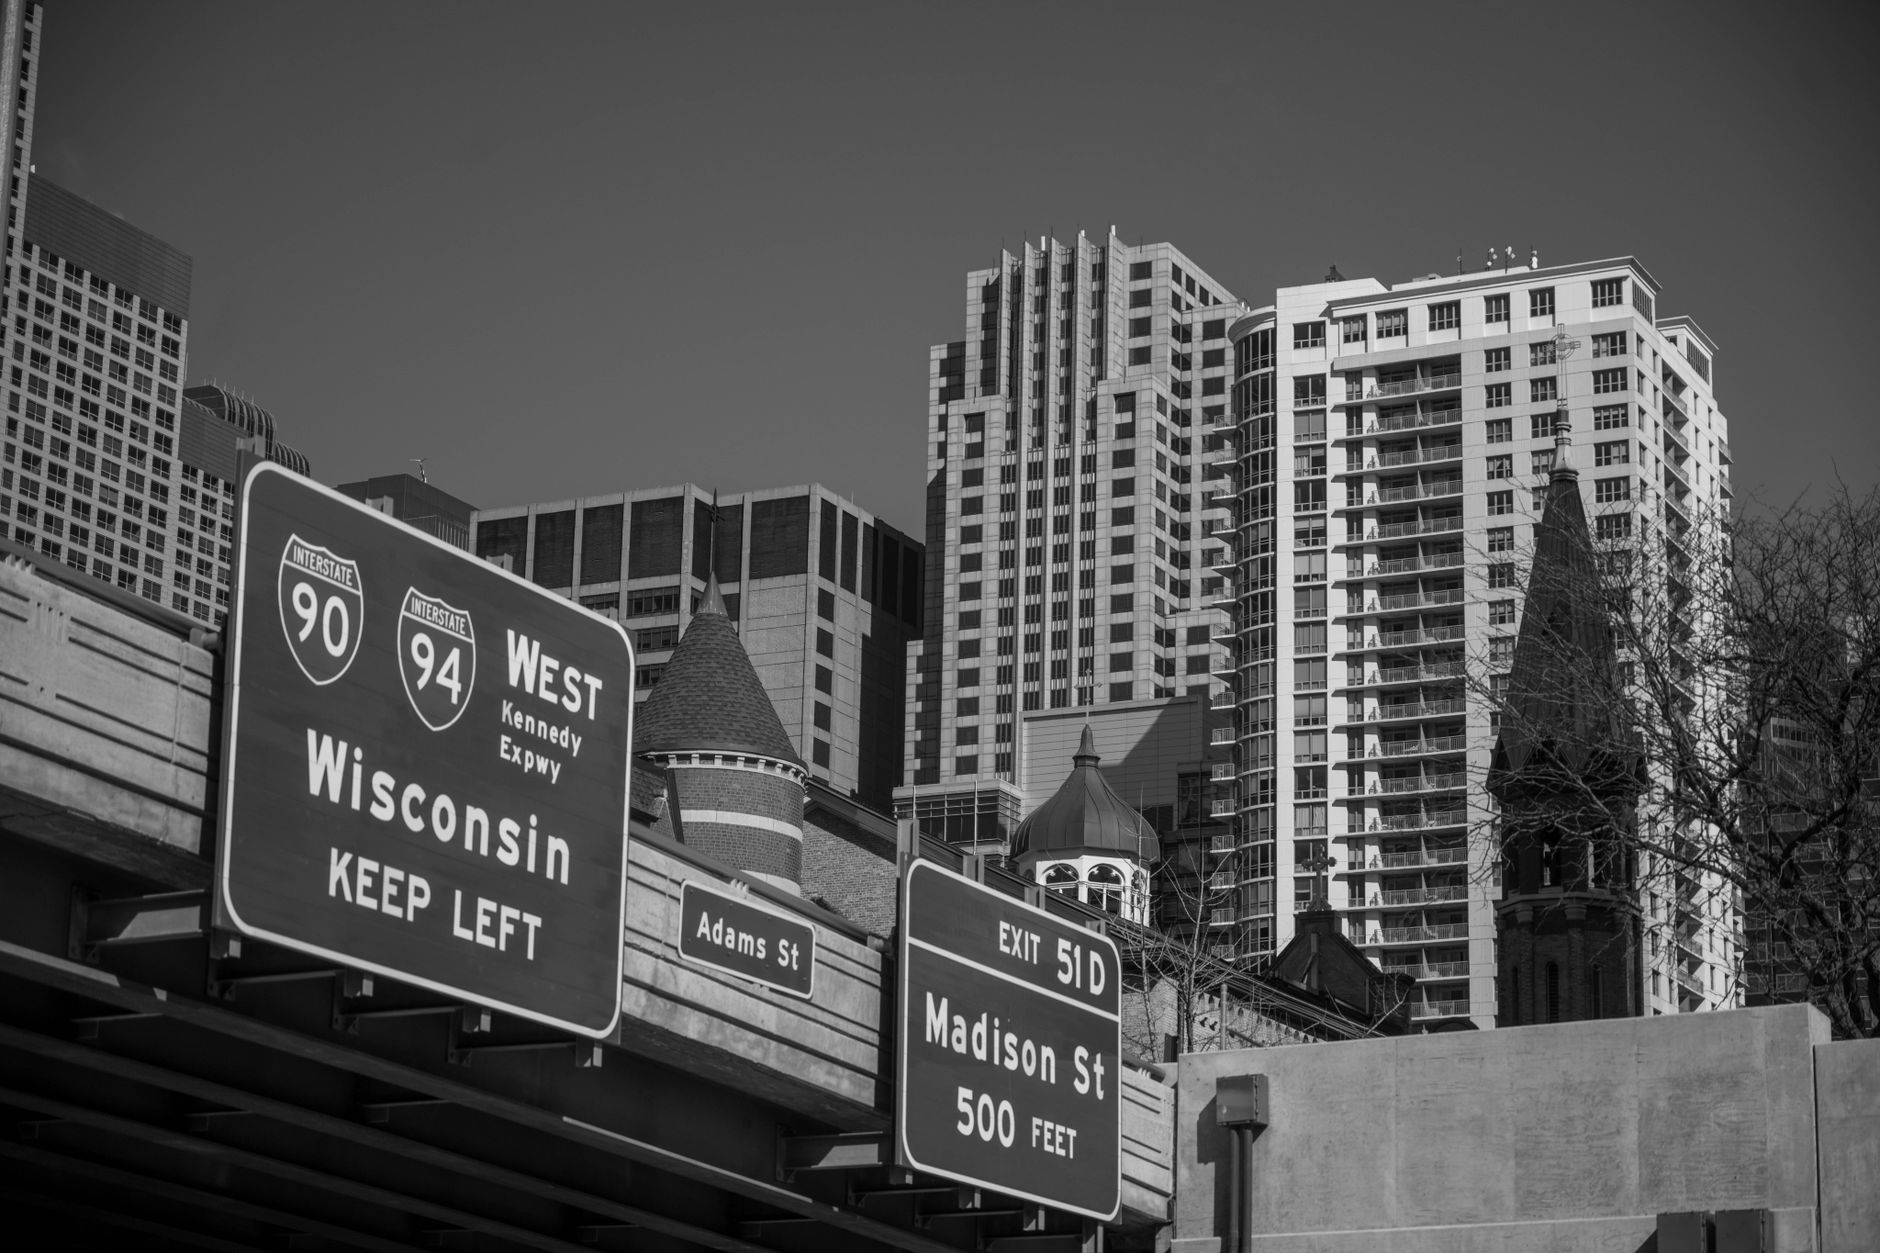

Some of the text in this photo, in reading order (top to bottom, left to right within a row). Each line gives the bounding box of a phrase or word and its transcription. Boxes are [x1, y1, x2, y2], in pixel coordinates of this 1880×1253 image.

[292, 545, 353, 587] INTERSTATE
[292, 581, 350, 657] 90
[411, 596, 466, 635] INTERSTATE
[411, 632, 462, 705] 94
[506, 629, 602, 721] WEST
[500, 737, 561, 784] Expwy
[501, 699, 582, 756] Kennedy
[307, 728, 569, 885] Wisconsin
[328, 847, 542, 961] KEEP LEFT
[697, 911, 799, 971] Adams St
[999, 920, 1106, 996] EXIT 51D
[925, 992, 1104, 1100] Madison St
[957, 1086, 1077, 1160] 500 FEET
